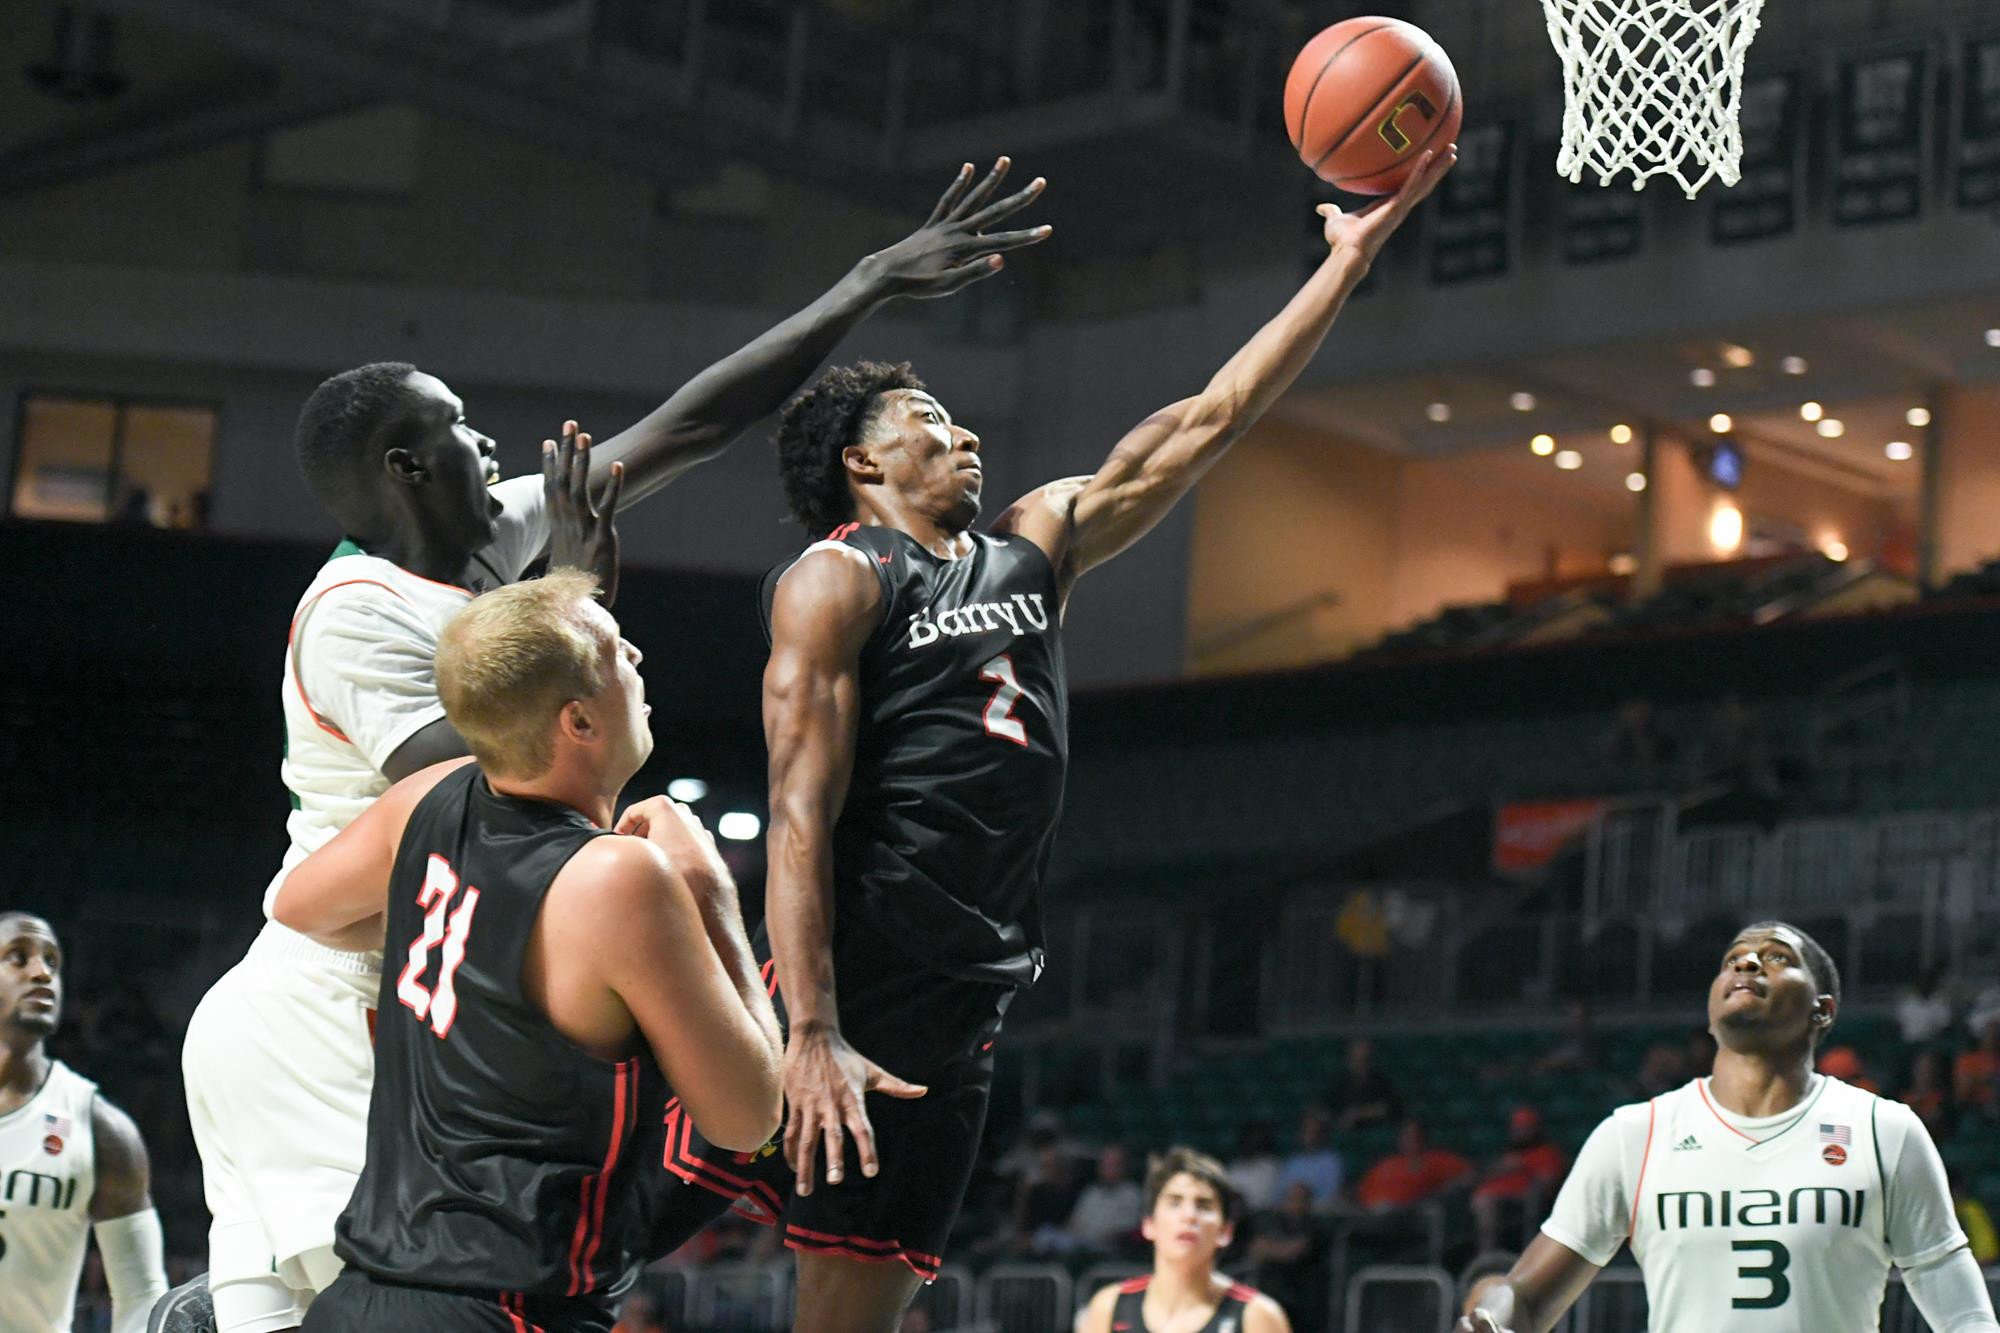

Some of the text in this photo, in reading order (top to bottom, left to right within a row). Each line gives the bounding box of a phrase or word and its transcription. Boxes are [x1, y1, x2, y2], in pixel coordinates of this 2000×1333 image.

[908, 594, 1048, 649] BarryU
[978, 653, 1029, 747] 2
[397, 853, 481, 1039] 21
[1731, 1239, 1791, 1309] 3
